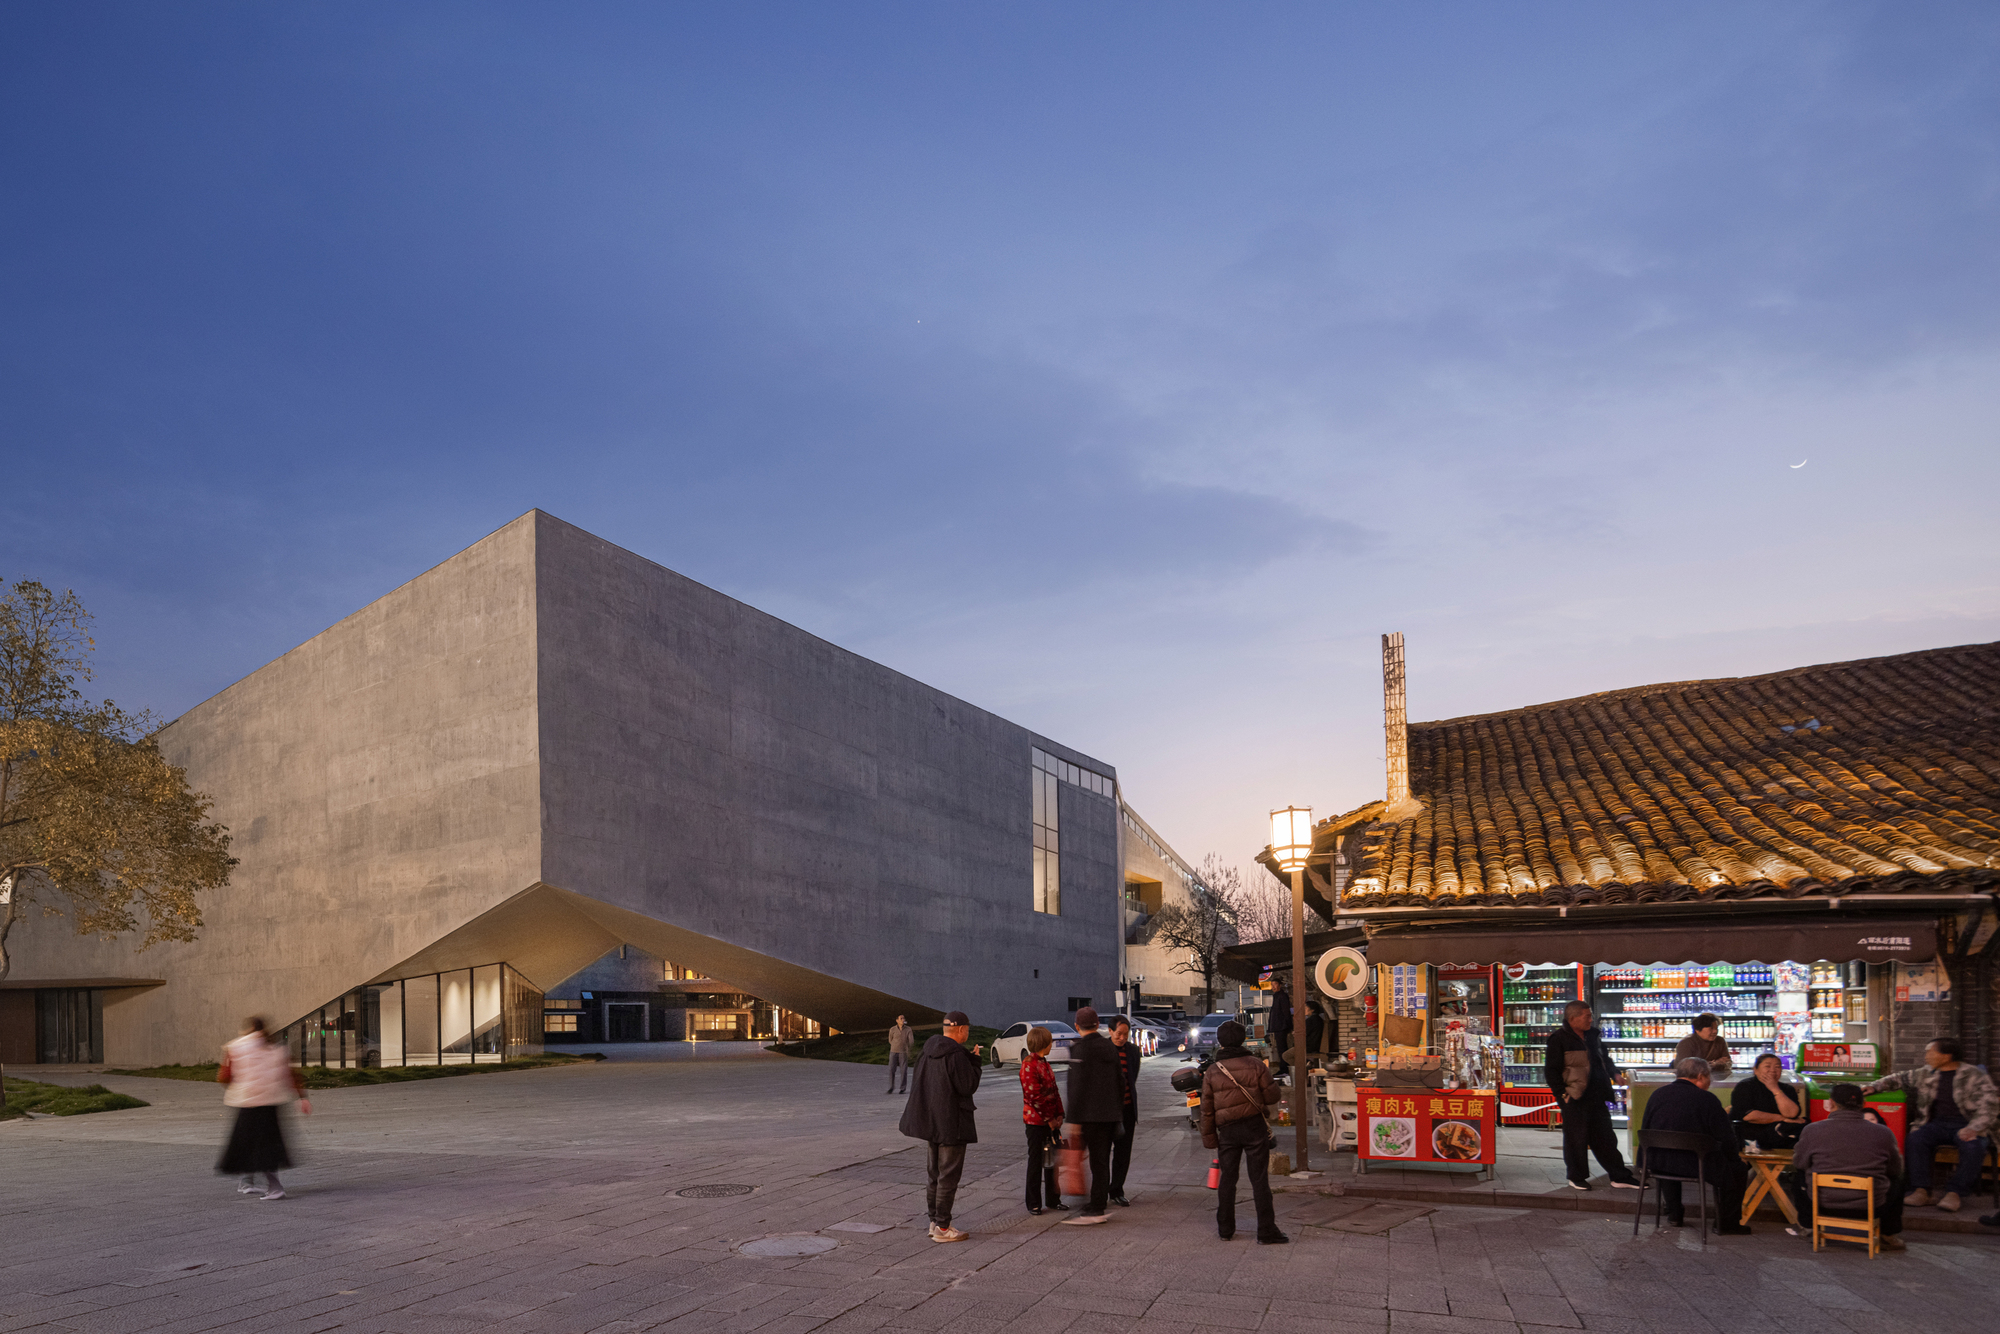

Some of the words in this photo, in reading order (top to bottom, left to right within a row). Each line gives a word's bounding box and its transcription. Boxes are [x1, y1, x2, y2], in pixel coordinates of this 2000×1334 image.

[1366, 1097, 1418, 1115] 瘦肉丸
[1429, 1098, 1484, 1117] 臭豆腐
